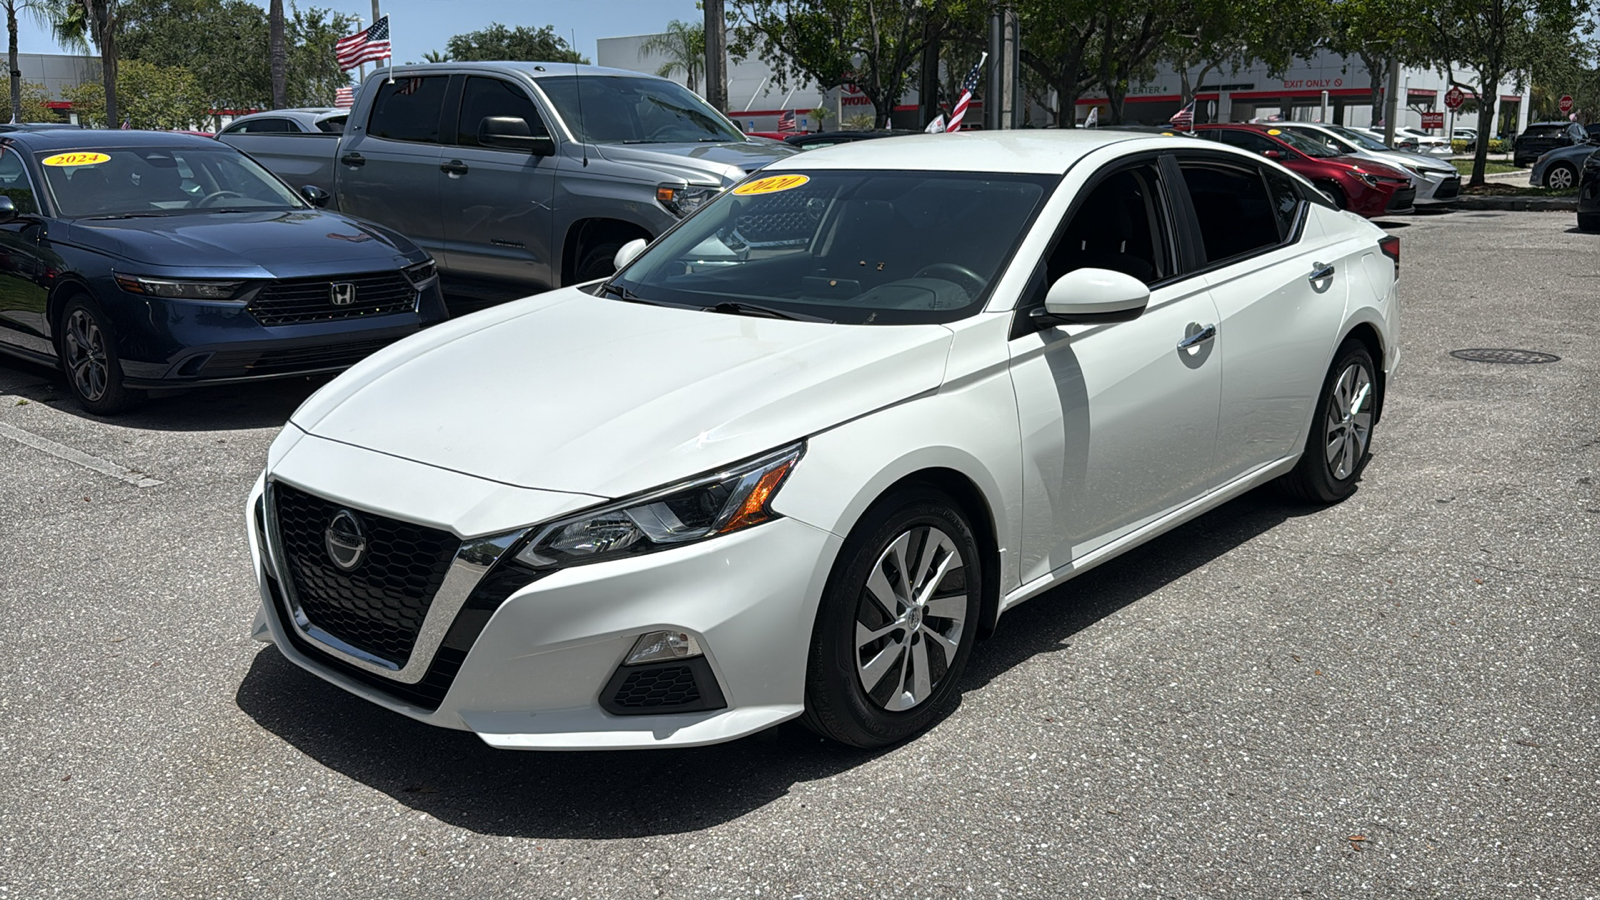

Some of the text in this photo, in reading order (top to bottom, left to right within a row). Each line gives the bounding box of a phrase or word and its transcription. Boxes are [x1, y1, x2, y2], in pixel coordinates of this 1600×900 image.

[1284, 79, 1330, 88] EXIT ONLY
[1132, 86, 1160, 95] ENTER
[841, 96, 872, 106] OYOTA
[55, 154, 98, 164] 2024
[740, 177, 801, 191] 2020
